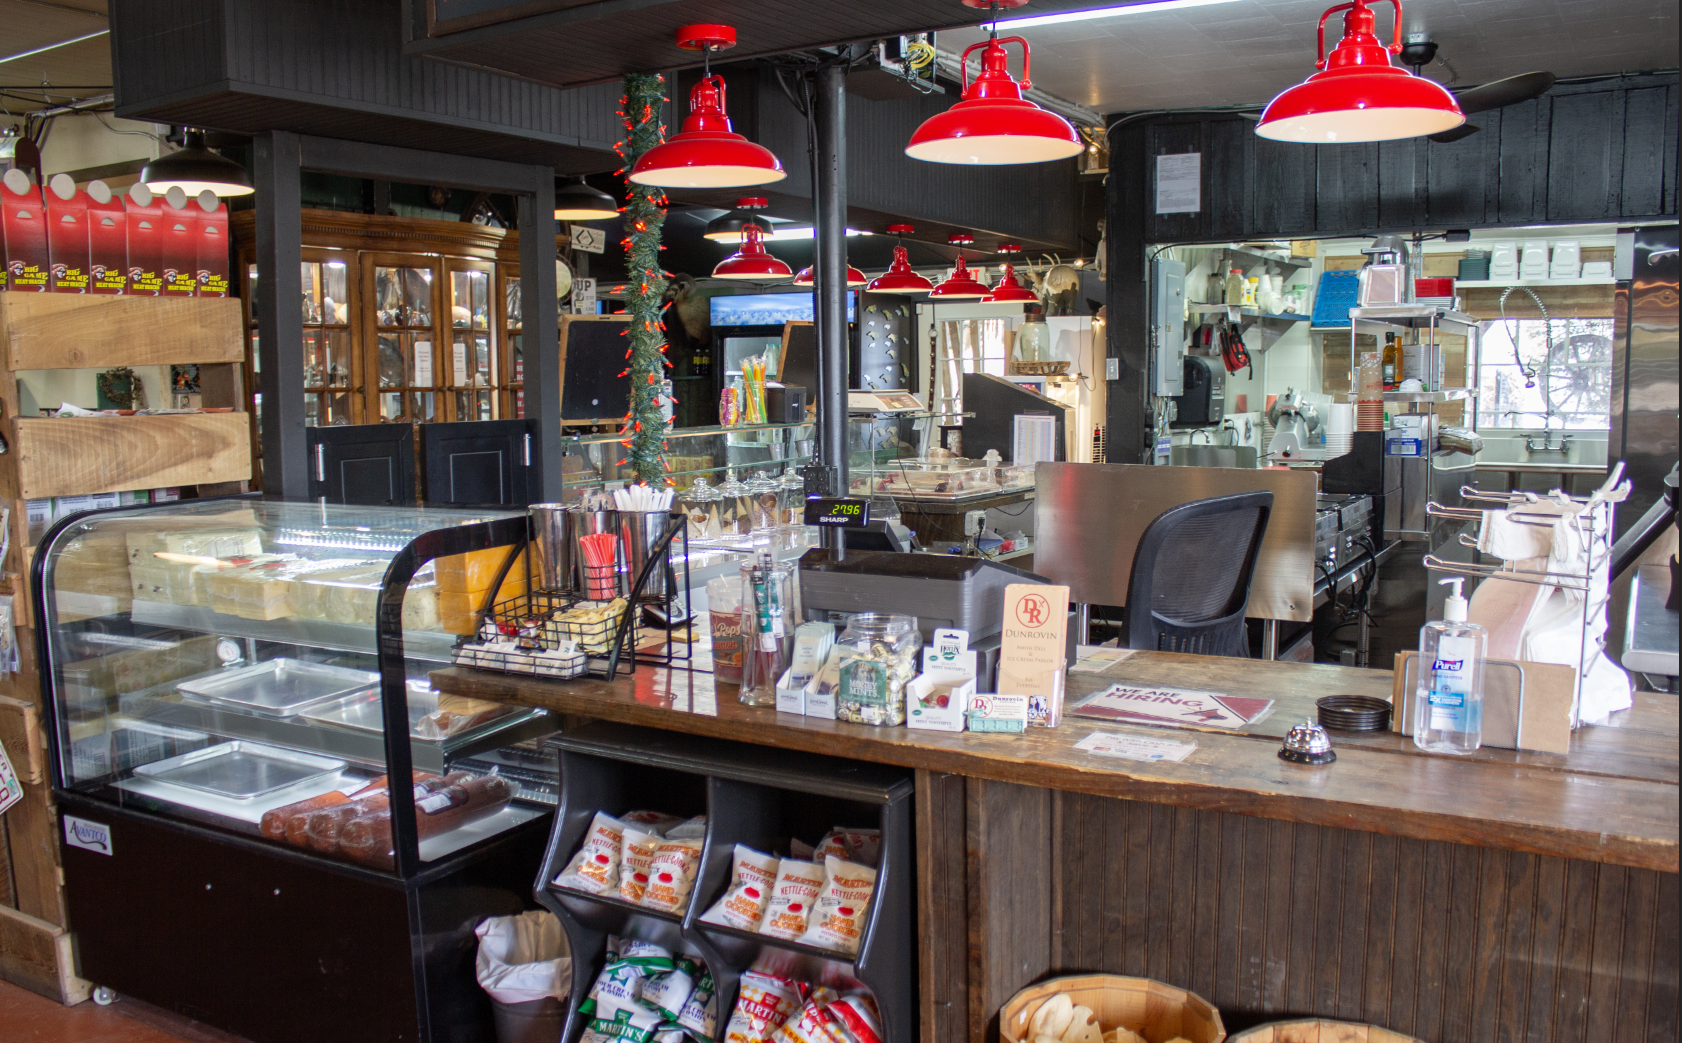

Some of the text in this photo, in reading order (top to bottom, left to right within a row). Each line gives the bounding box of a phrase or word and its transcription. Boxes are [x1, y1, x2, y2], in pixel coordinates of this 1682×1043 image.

[104, 276, 126, 284] GAME
[141, 278, 162, 286] GAME
[1435, 660, 1461, 670] Purell
[1105, 692, 1204, 707] HIRING
[69, 820, 107, 844] AVANTCO
[652, 883, 674, 895] HAND
[646, 890, 679, 905] COOKED
[734, 895, 759, 911] HAND
[725, 900, 762, 922] COOKED
[778, 913, 803, 923] HAND
[769, 919, 807, 934] COOKED
[829, 914, 854, 928] HAND
[820, 922, 859, 939] COOKED
[607, 989, 626, 999] ONION
[613, 985, 635, 999] CREAM
[599, 1020, 643, 1040] MARTIN'S
